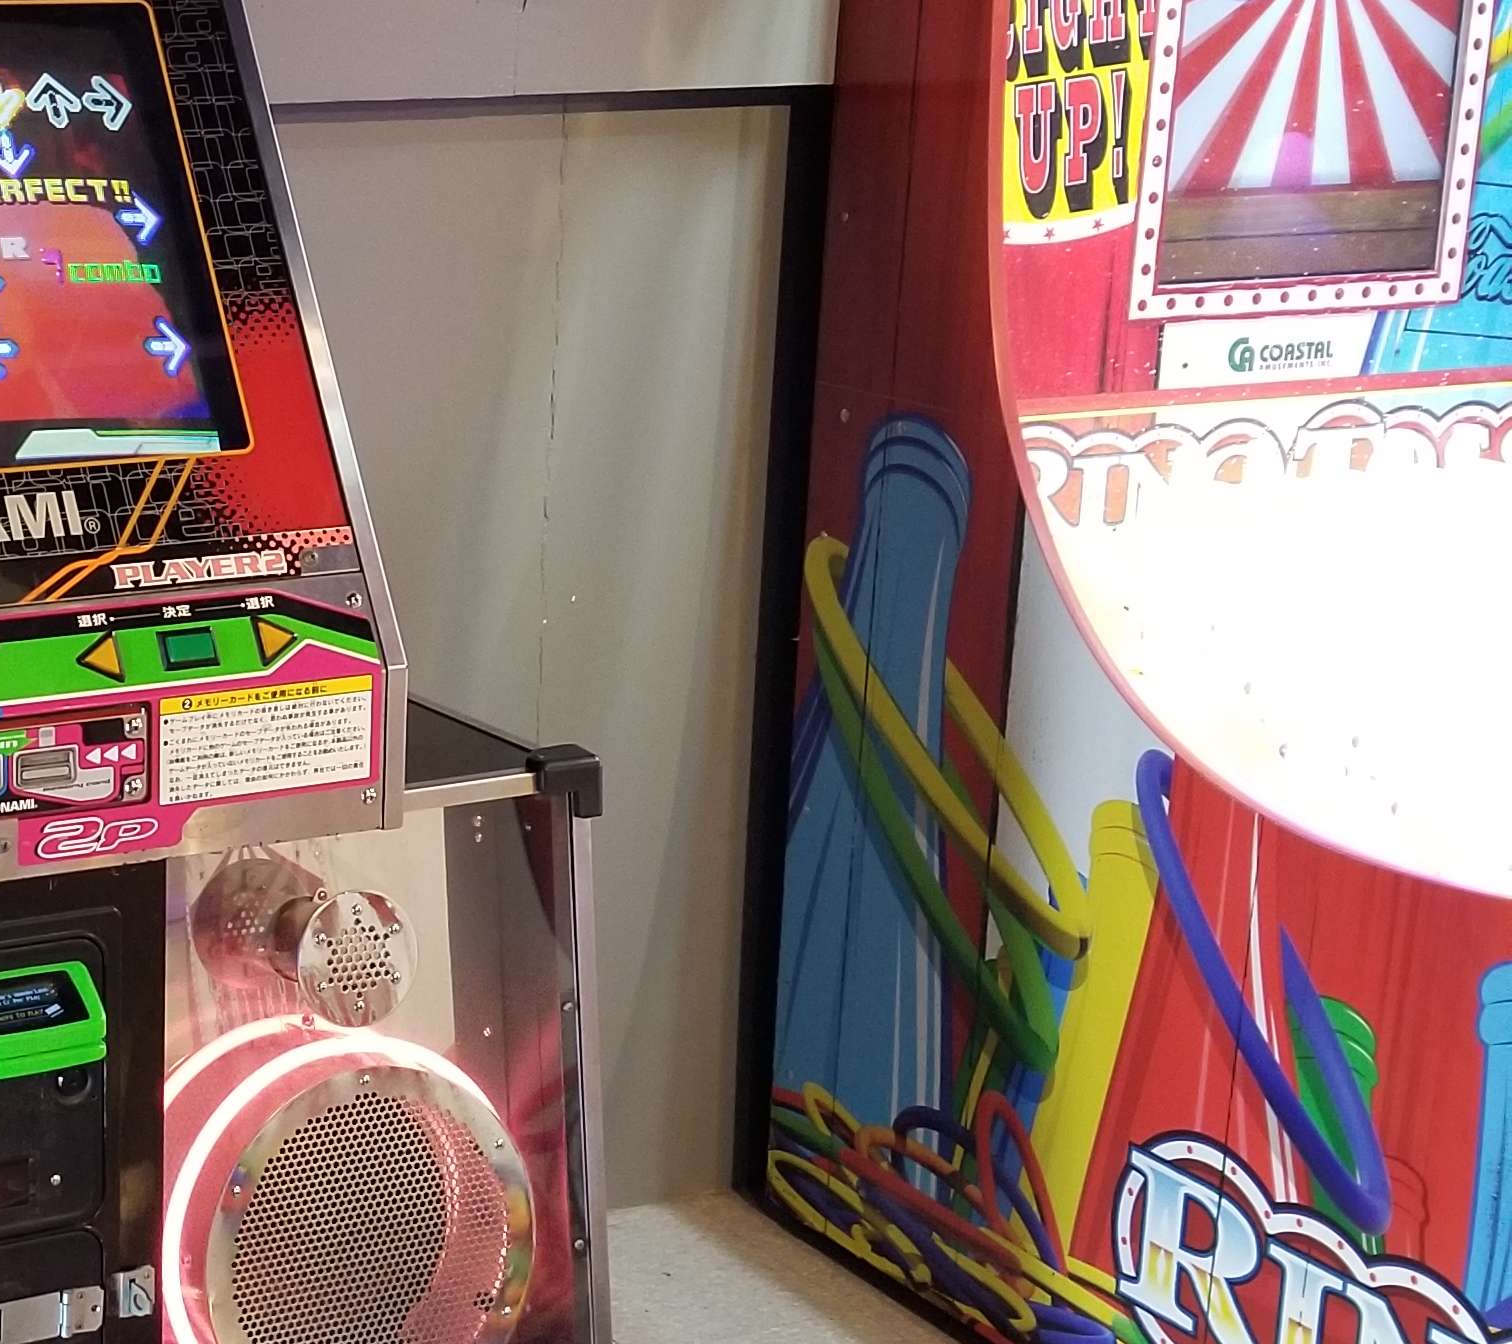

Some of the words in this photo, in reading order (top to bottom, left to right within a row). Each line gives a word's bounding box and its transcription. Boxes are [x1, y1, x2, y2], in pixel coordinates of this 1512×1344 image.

[1014, 69, 1128, 195] UP!
[66, 260, 162, 285] combo
[1259, 340, 1334, 362] COASTAL
[76, 613, 108, 628] 選択
[161, 604, 192, 618] 決定
[244, 595, 275, 611] 選択
